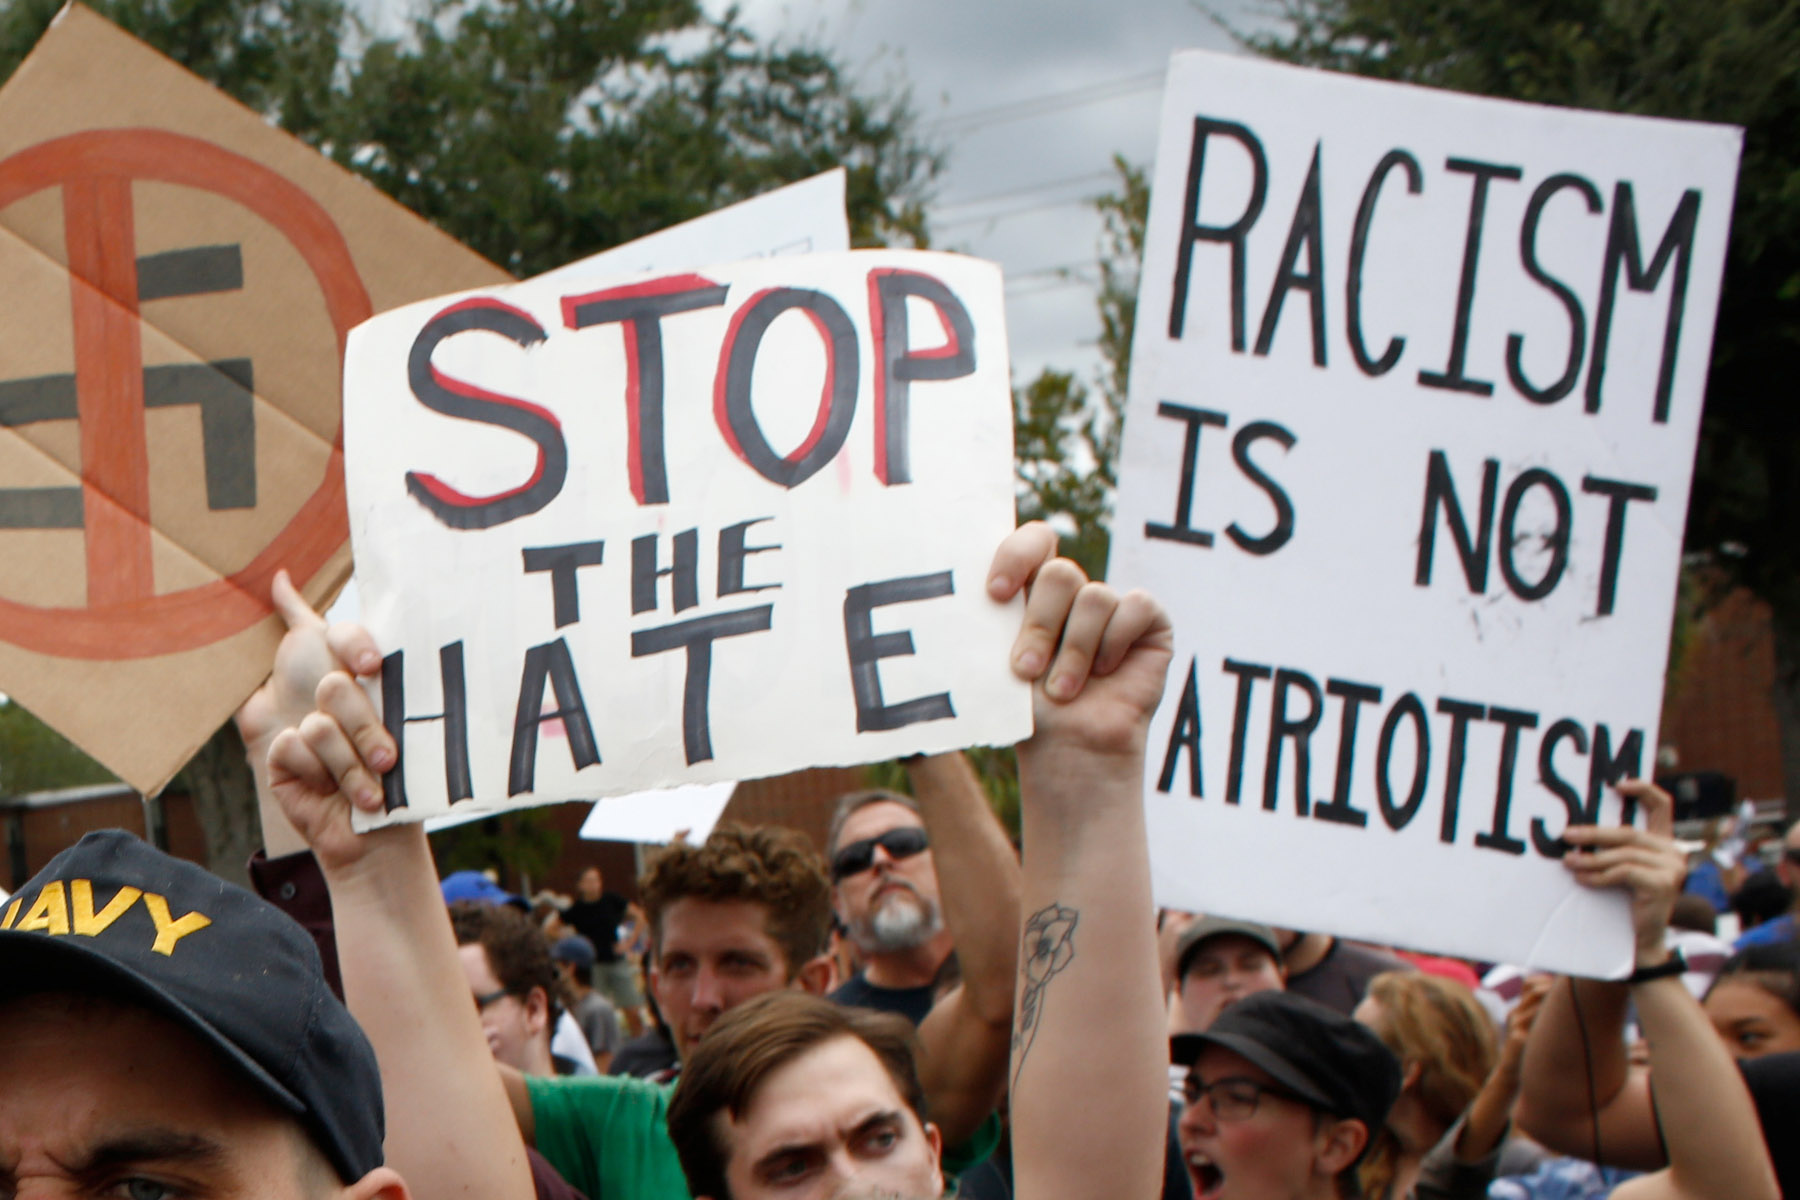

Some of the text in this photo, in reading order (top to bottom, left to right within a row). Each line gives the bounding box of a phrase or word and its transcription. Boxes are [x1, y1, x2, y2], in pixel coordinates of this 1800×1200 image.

[1168, 114, 1703, 424] RACISM
[404, 266, 977, 531] STOP
[1144, 401, 1658, 618] IS NOT
[522, 517, 784, 630] THE
[380, 570, 958, 816] HATE
[1156, 654, 1644, 861] ATRIOTISM
